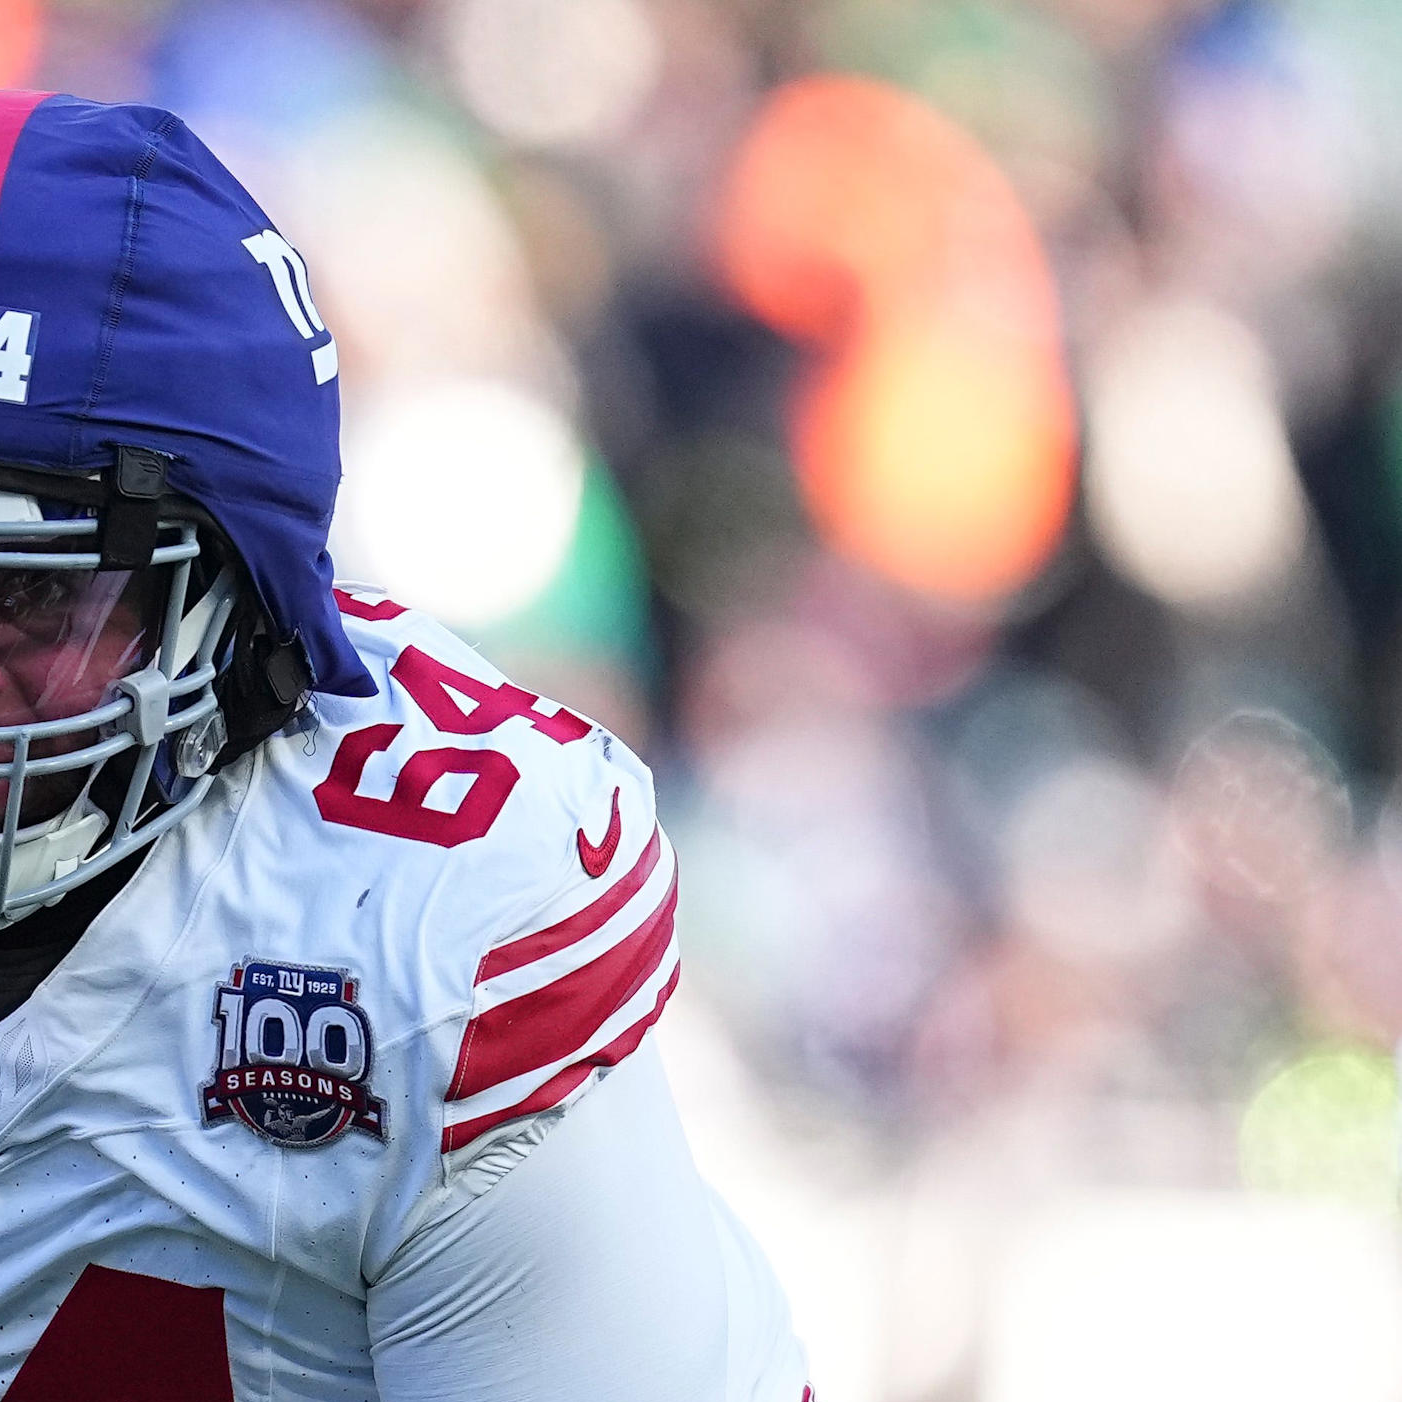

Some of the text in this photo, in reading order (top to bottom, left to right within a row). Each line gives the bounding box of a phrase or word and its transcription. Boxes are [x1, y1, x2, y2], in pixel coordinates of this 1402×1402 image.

[312, 644, 593, 849] 64
[252, 972, 275, 988] EST.
[307, 980, 338, 995] 1925
[219, 991, 366, 1082] 100
[227, 1070, 354, 1102] SEASONS
